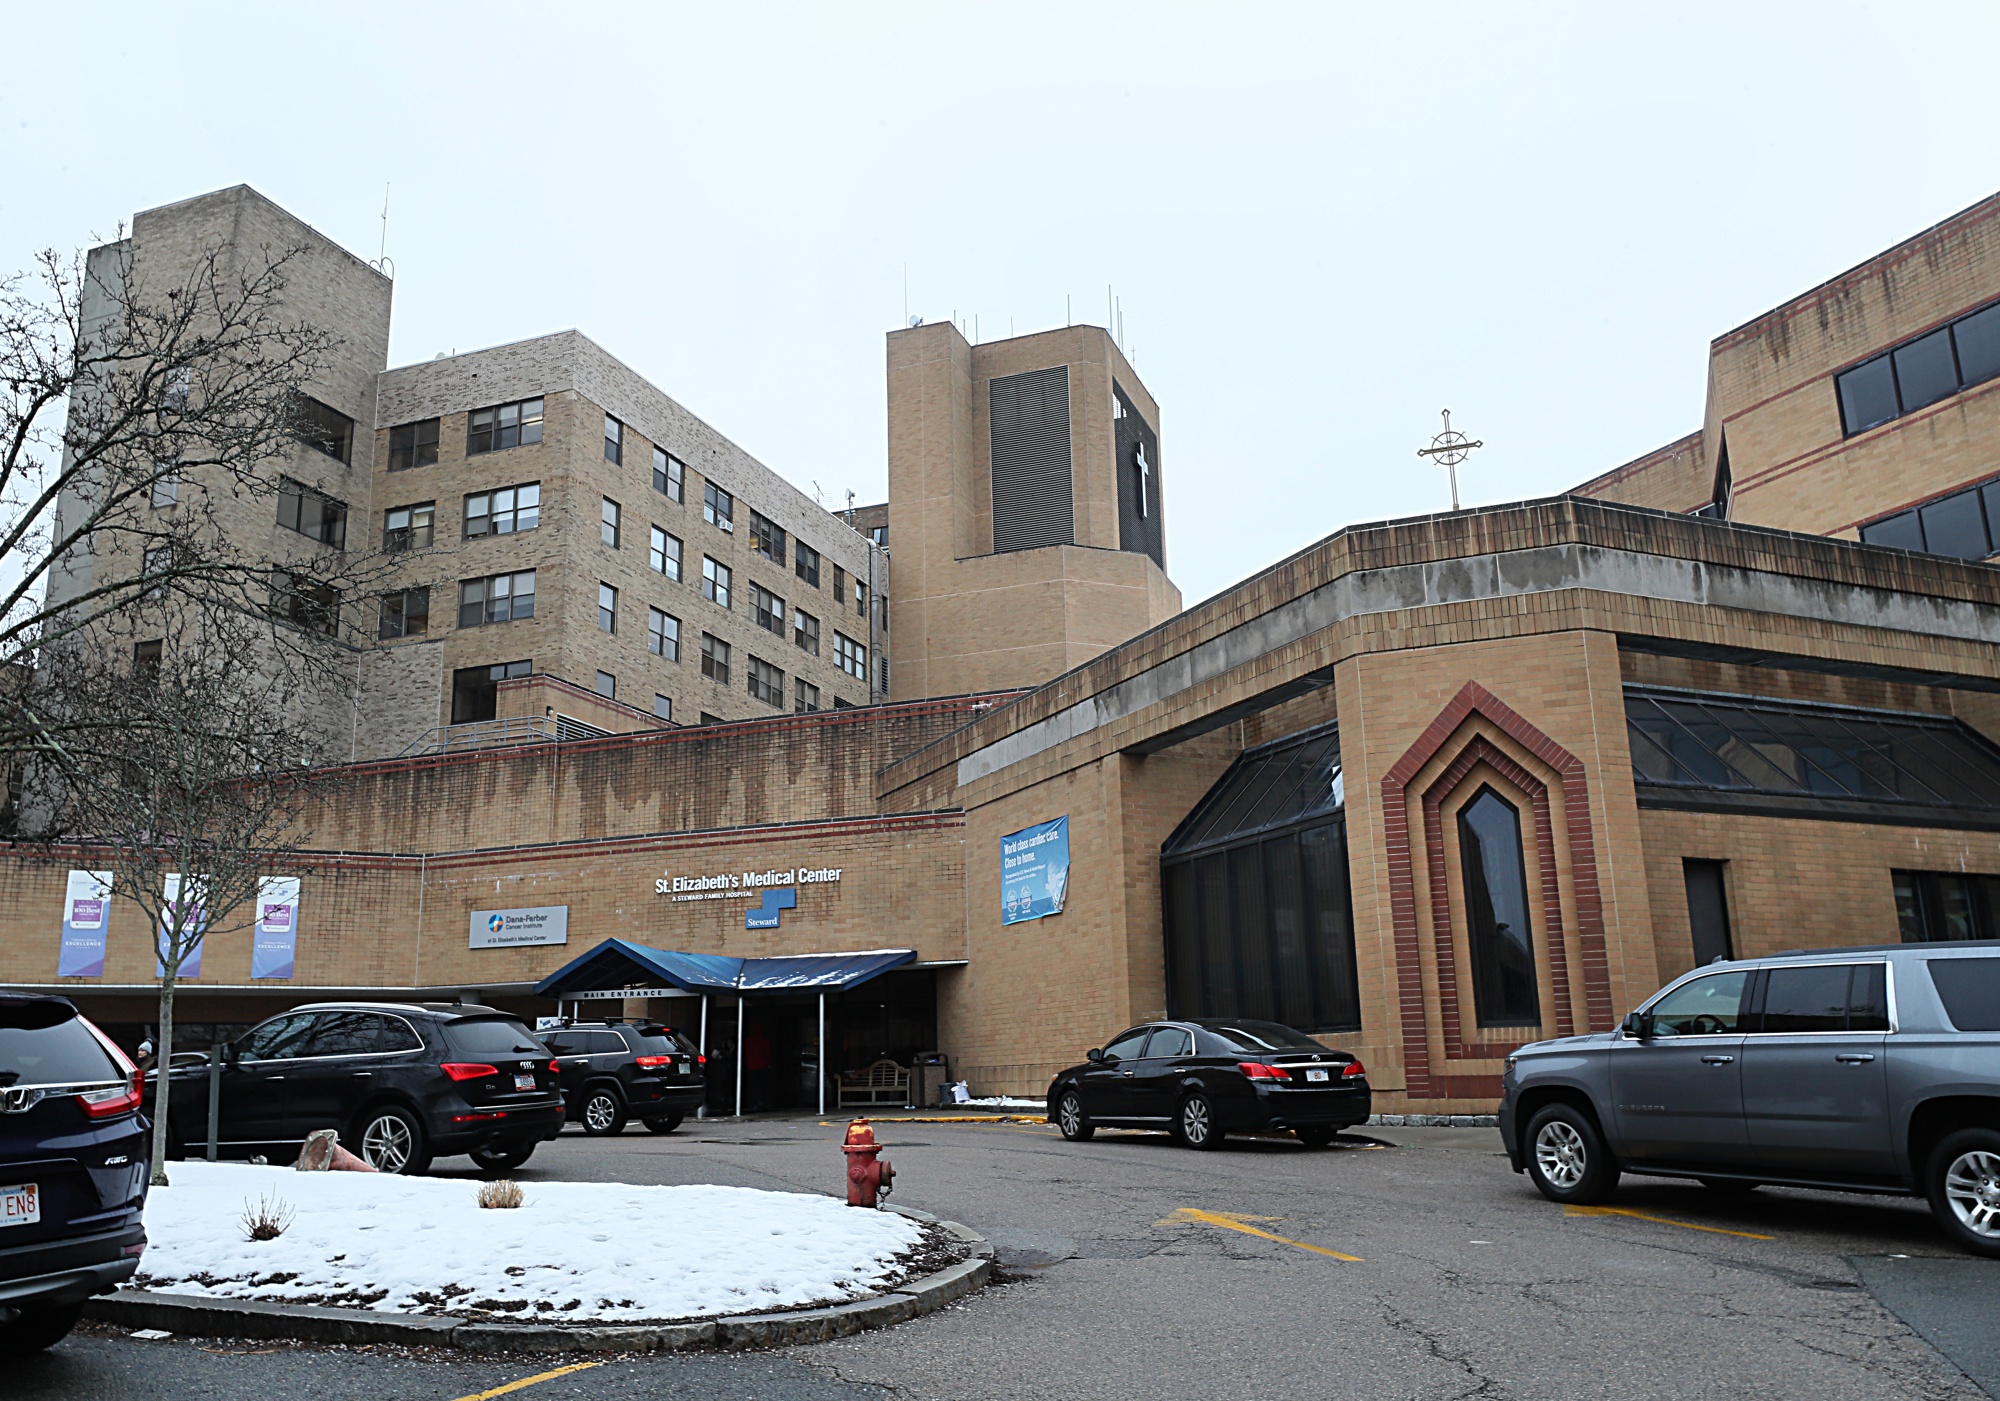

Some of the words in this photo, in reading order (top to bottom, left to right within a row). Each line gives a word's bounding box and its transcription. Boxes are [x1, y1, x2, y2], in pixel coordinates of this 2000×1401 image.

[1004, 842, 1017, 855] World
[1017, 839, 1029, 851] class
[1029, 833, 1046, 848] cardiac
[1004, 856, 1016, 868] Close
[1017, 854, 1021, 865] to
[655, 878, 671, 893] St.
[673, 874, 739, 892] Elizabeth's
[742, 868, 795, 887] Medical
[798, 867, 842, 883] Center
[725, 890, 753, 898] HOSPITAL
[506, 914, 548, 923] Dana-Farber
[747, 917, 778, 926] Steward
[6, 1194, 36, 1216] EN8
